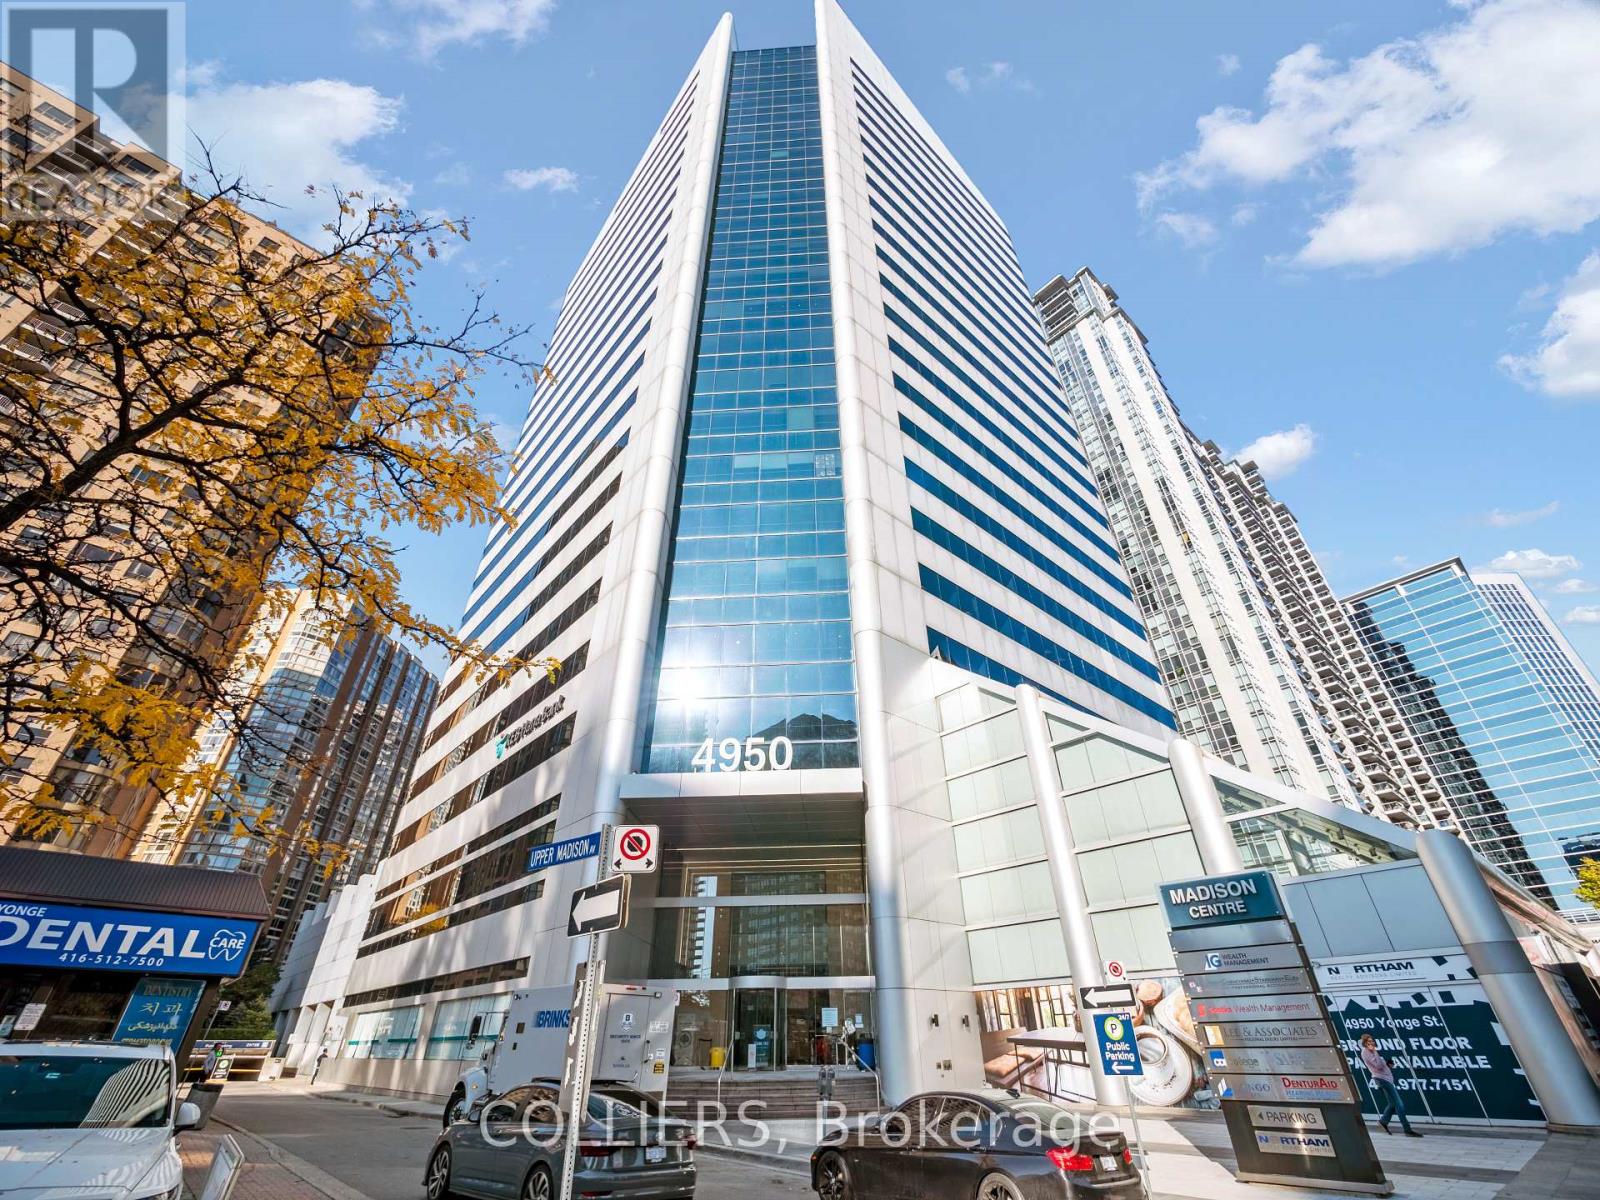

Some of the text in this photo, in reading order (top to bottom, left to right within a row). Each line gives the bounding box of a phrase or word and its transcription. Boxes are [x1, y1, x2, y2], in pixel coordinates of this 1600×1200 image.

[691, 736, 793, 772] 4950
[530, 846, 555, 868] UPPER
[556, 838, 590, 861] MADISON
[1169, 879, 1257, 905] MADISON
[0, 903, 47, 917] YONGE
[1189, 900, 1247, 918] CENTRE
[0, 915, 206, 958] DENTAL
[209, 936, 246, 950] CARE
[58, 952, 165, 967] 416-512-7500
[1222, 953, 1247, 961] WEALTH
[1223, 957, 1270, 967] MANAGEMENT
[1327, 961, 1415, 975] NRTHAM
[1233, 1004, 1259, 1013] Wealth
[1260, 1003, 1310, 1013] Management
[535, 1009, 571, 1028] BRINKS
[1345, 1015, 1443, 1030] 4950 Yonge St.
[1243, 1027, 1252, 1036] &
[1254, 1026, 1318, 1037] ASSOCIATES
[1105, 1041, 1131, 1051] Public
[1410, 1036, 1473, 1050] FLOOR
[1105, 1051, 1135, 1062] Parking
[1393, 1055, 1492, 1069] AVAILABLE
[1265, 1111, 1317, 1124] PARKING
[1258, 1135, 1329, 1147] NRTHAM
